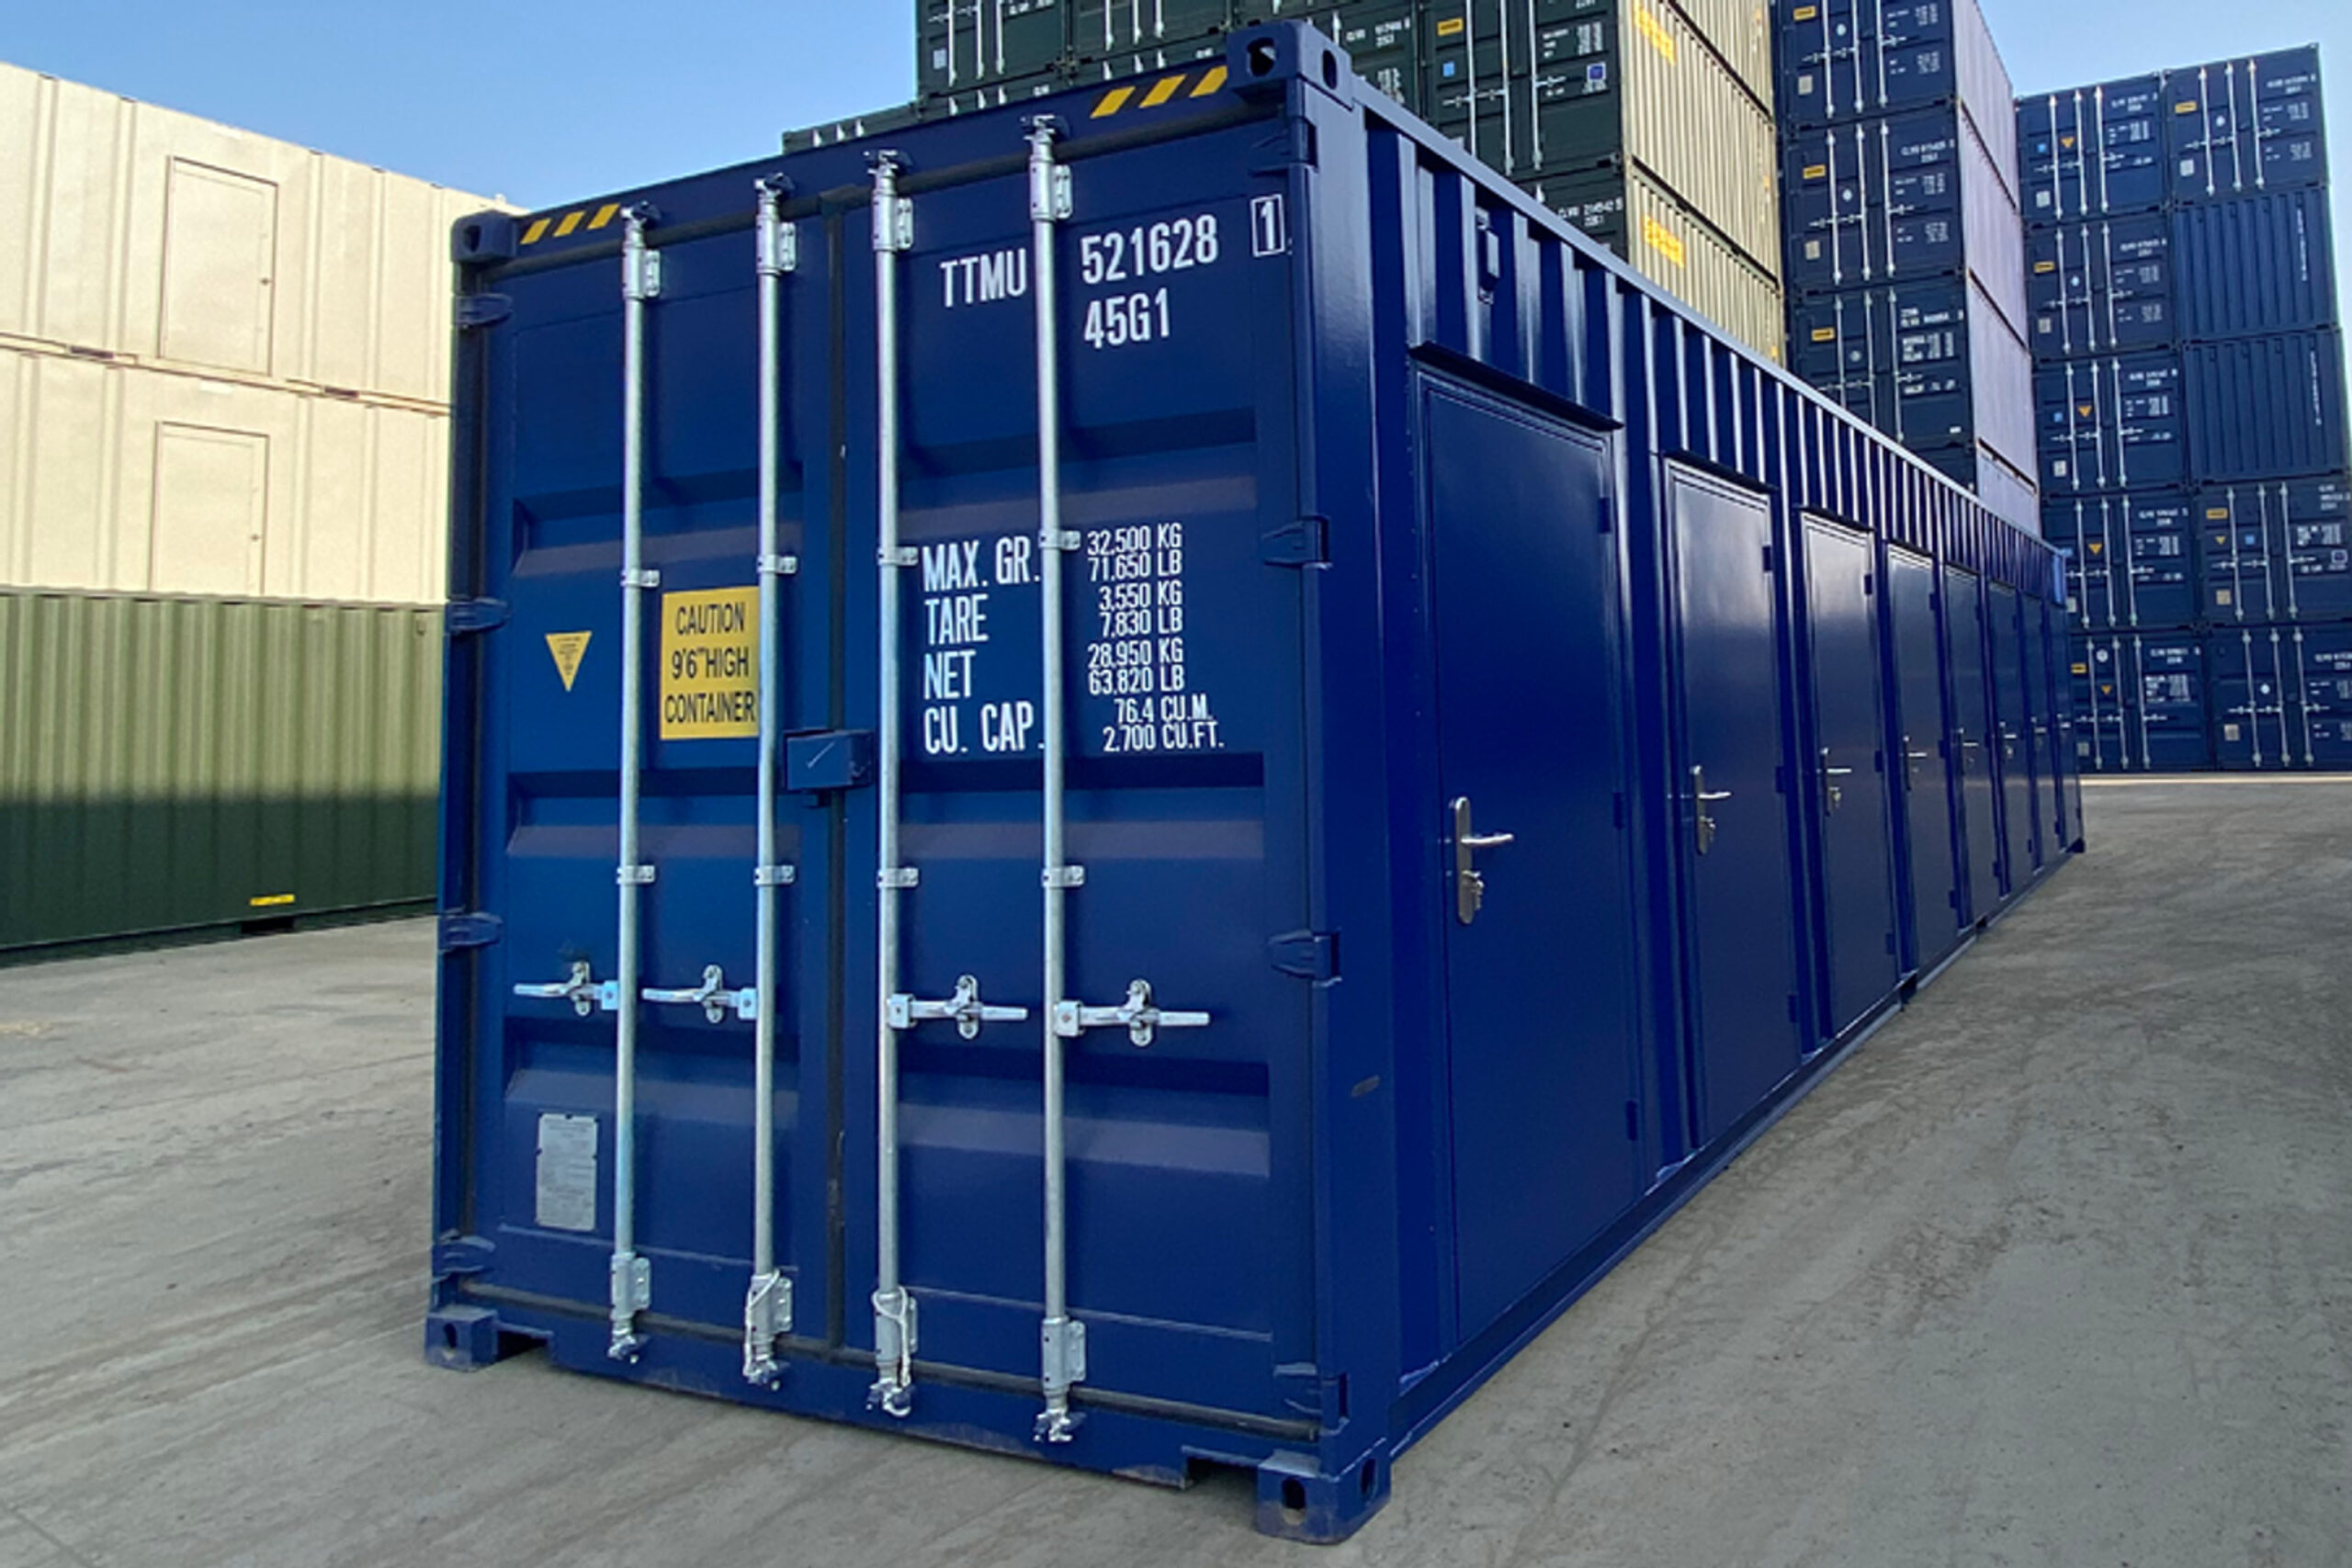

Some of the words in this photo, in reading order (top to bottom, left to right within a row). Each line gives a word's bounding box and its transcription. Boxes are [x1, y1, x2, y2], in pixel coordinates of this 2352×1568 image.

[940, 248, 1027, 308] TTMU
[1080, 214, 1219, 285] 521628
[1084, 287, 1170, 349] 45G1
[1158, 522, 1183, 549] KG
[922, 539, 989, 592] MAX.
[995, 535, 1041, 585] GR.
[1158, 548, 1183, 577] LB
[1158, 579, 1184, 606] KG
[675, 601, 745, 636] CAUTION
[924, 592, 989, 645] TARE
[1158, 605, 1184, 635] LB
[1158, 636, 1184, 664] KG
[924, 649, 977, 700] NET
[1159, 663, 1186, 693] LB
[664, 690, 756, 724] CONTAINER
[1114, 696, 1155, 724] 76.4
[924, 705, 968, 755] CU.
[1161, 720, 1226, 750] CU.FT.
